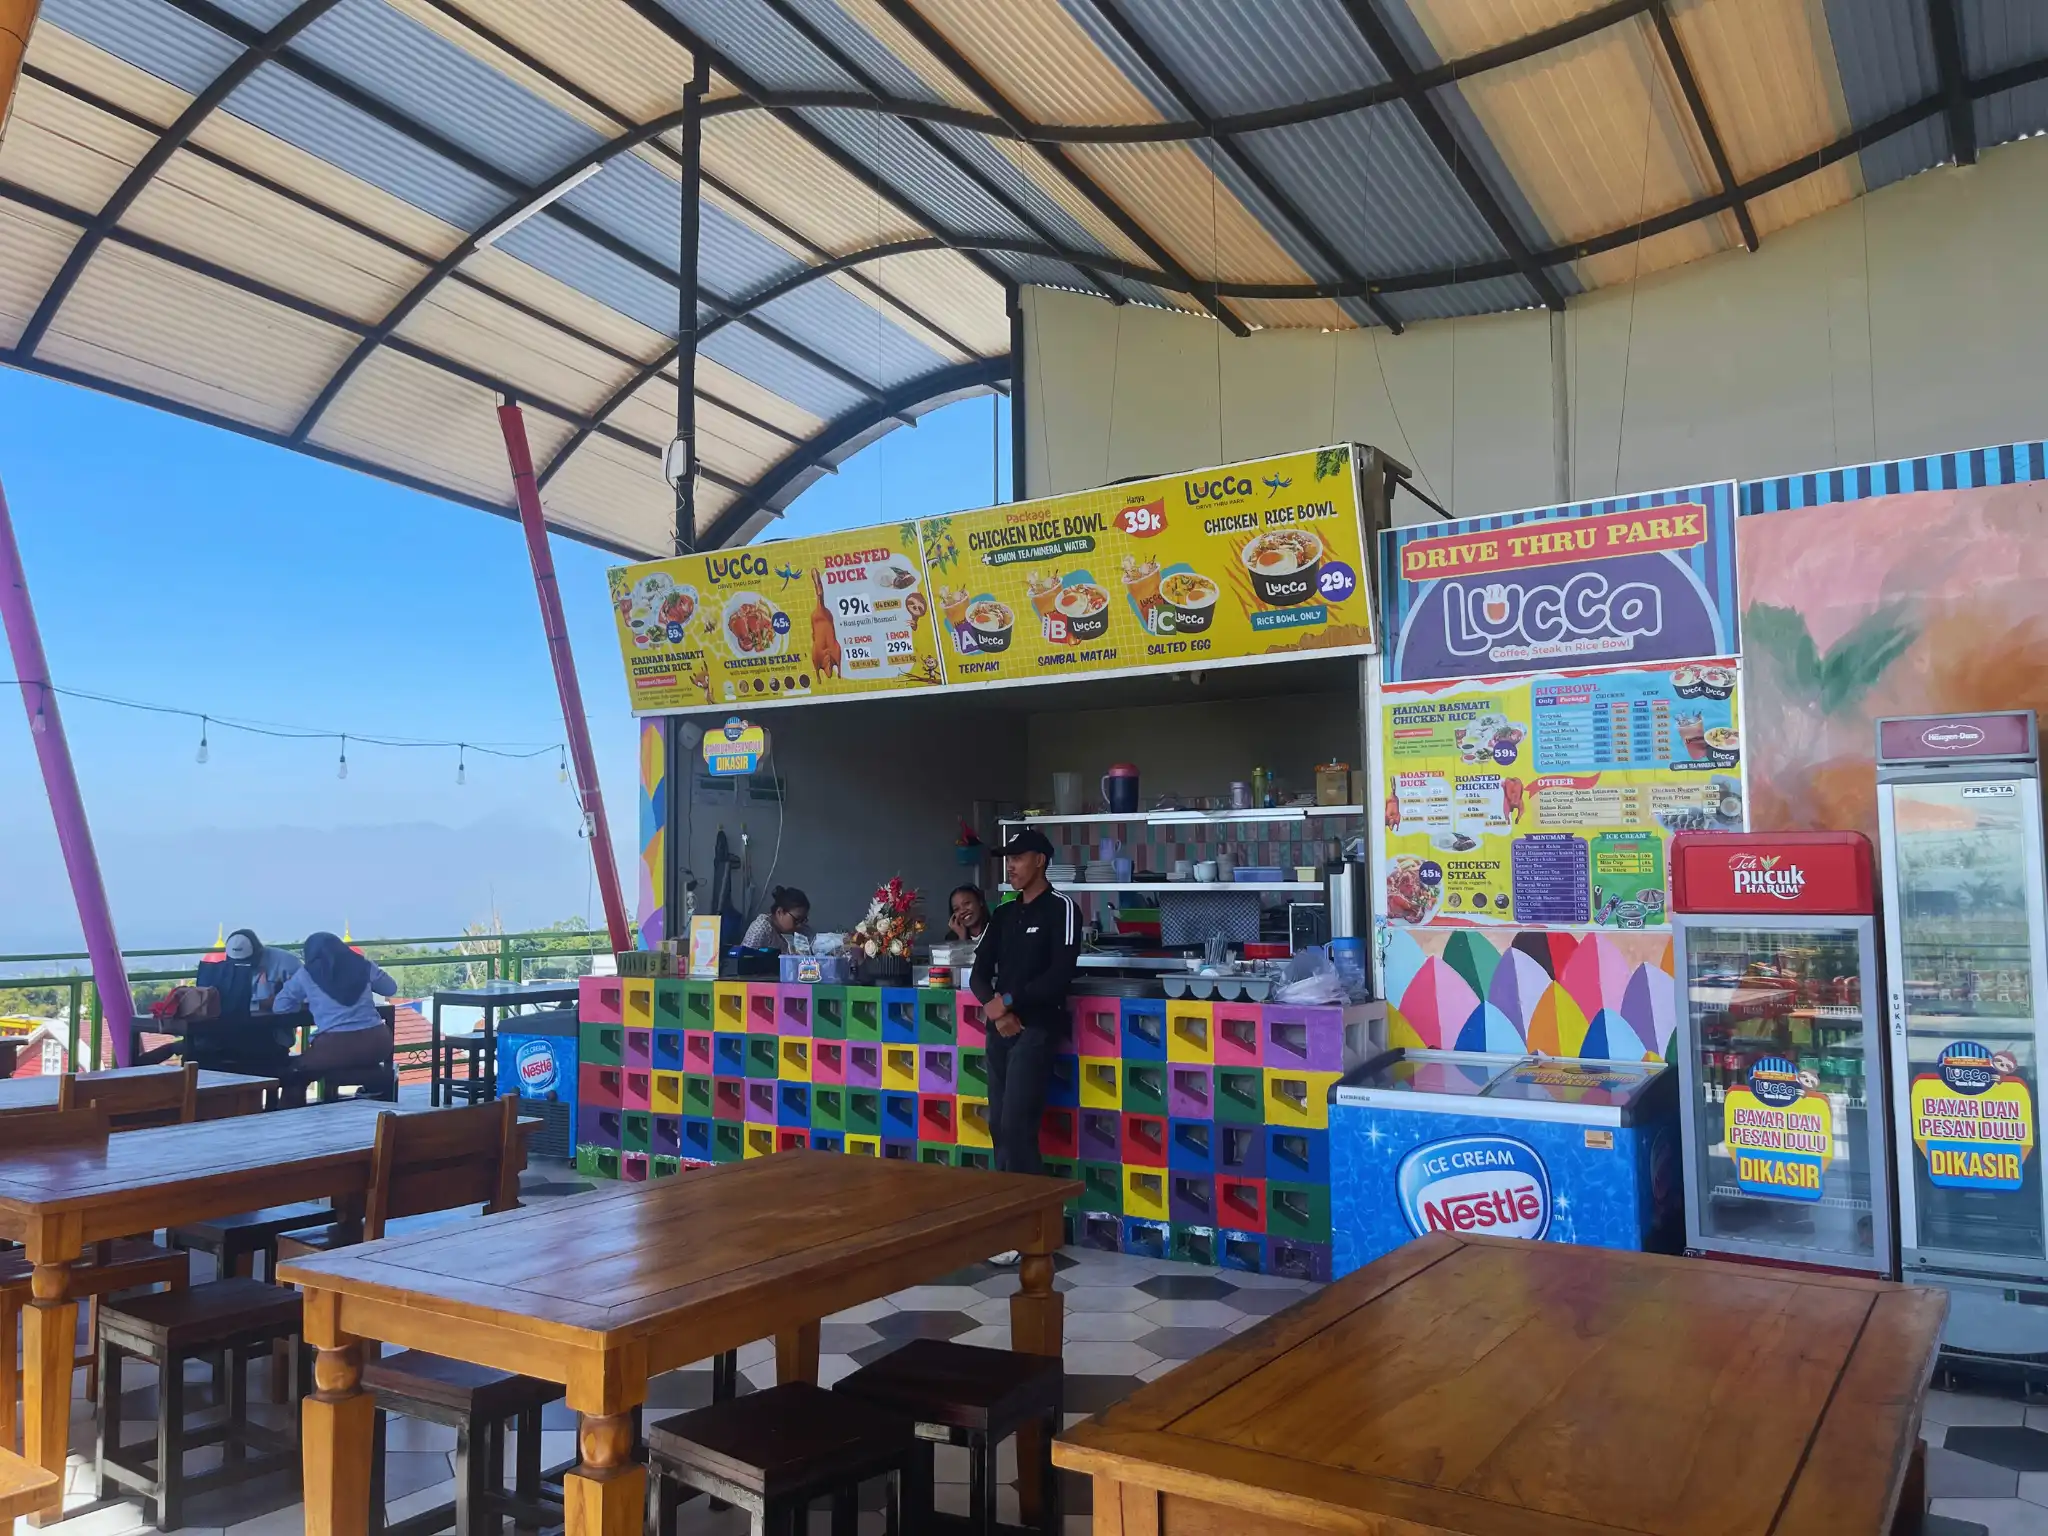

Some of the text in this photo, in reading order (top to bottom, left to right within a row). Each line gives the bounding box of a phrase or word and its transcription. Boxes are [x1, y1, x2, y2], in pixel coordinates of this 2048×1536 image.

[1126, 496, 1145, 504] Hanya
[1006, 508, 1050, 524] Package
[1204, 500, 1338, 535] CHICKEN RICE BOWL
[968, 512, 1108, 551] CHICKEN RICE BOWL
[1406, 513, 1700, 572] DRIVE THRU PARK
[824, 548, 891, 568] ROASTED
[994, 553, 1017, 564] LEMON
[1017, 544, 1063, 559] TEA/MINERAL
[1063, 539, 1088, 552] WATER
[826, 567, 868, 584] DUCK
[839, 597, 871, 616] 99k
[884, 600, 899, 608] EKOR
[773, 617, 789, 628] 45k
[1158, 611, 1174, 631] C
[1256, 610, 1321, 626] RICE BOWL ONLY
[890, 630, 910, 640] EKOR
[1050, 620, 1066, 638] B
[855, 635, 873, 644] EKOR
[887, 641, 912, 653] 299k
[962, 630, 978, 650] A
[1147, 639, 1211, 656] SALTED EGG
[845, 648, 870, 659] 189k
[1492, 648, 1530, 660] Coffee,
[1532, 643, 1562, 655] Steak
[1575, 640, 1601, 652] Rice
[1602, 637, 1631, 650] Bowl
[631, 650, 704, 665] HAINAN BASMATI
[724, 653, 801, 669] CHICKEN STEAK
[1037, 649, 1117, 667] SAMBAL MATAH
[633, 662, 692, 675] CHICKEN RICE
[958, 661, 1000, 674] TERIYAKI
[1536, 684, 1600, 696] RICEBOWL
[1393, 701, 1490, 715] HAINAN BASMATI
[1393, 712, 1476, 725] CHICKEN RICE
[1494, 749, 1516, 758] 59k
[1400, 770, 1444, 779] ROASTED
[1455, 774, 1501, 783] ROASTED
[1537, 778, 1574, 786] OTHER
[1455, 782, 1500, 791] CHICKEN
[1964, 786, 2013, 794] FRESTA
[1447, 861, 1501, 869] CHICKEN
[1735, 855, 1757, 869] Teh
[1421, 870, 1441, 878] 45k
[1448, 871, 1487, 880] STEAK
[1733, 864, 1806, 894] pucuk
[1746, 884, 1799, 894] HARUM
[1893, 993, 1902, 1029] BUKA
[1923, 1097, 2020, 1119] BAYAR DAN
[1733, 1107, 1822, 1132] BAYAR DAN
[1919, 1118, 2027, 1141] PESAN DULU
[1730, 1127, 1827, 1154] PESAN DULU
[1423, 1150, 1515, 1177] ICE CREAM
[1930, 1149, 2022, 1181] DIKASIR
[1738, 1157, 1821, 1190] DIKASIR
